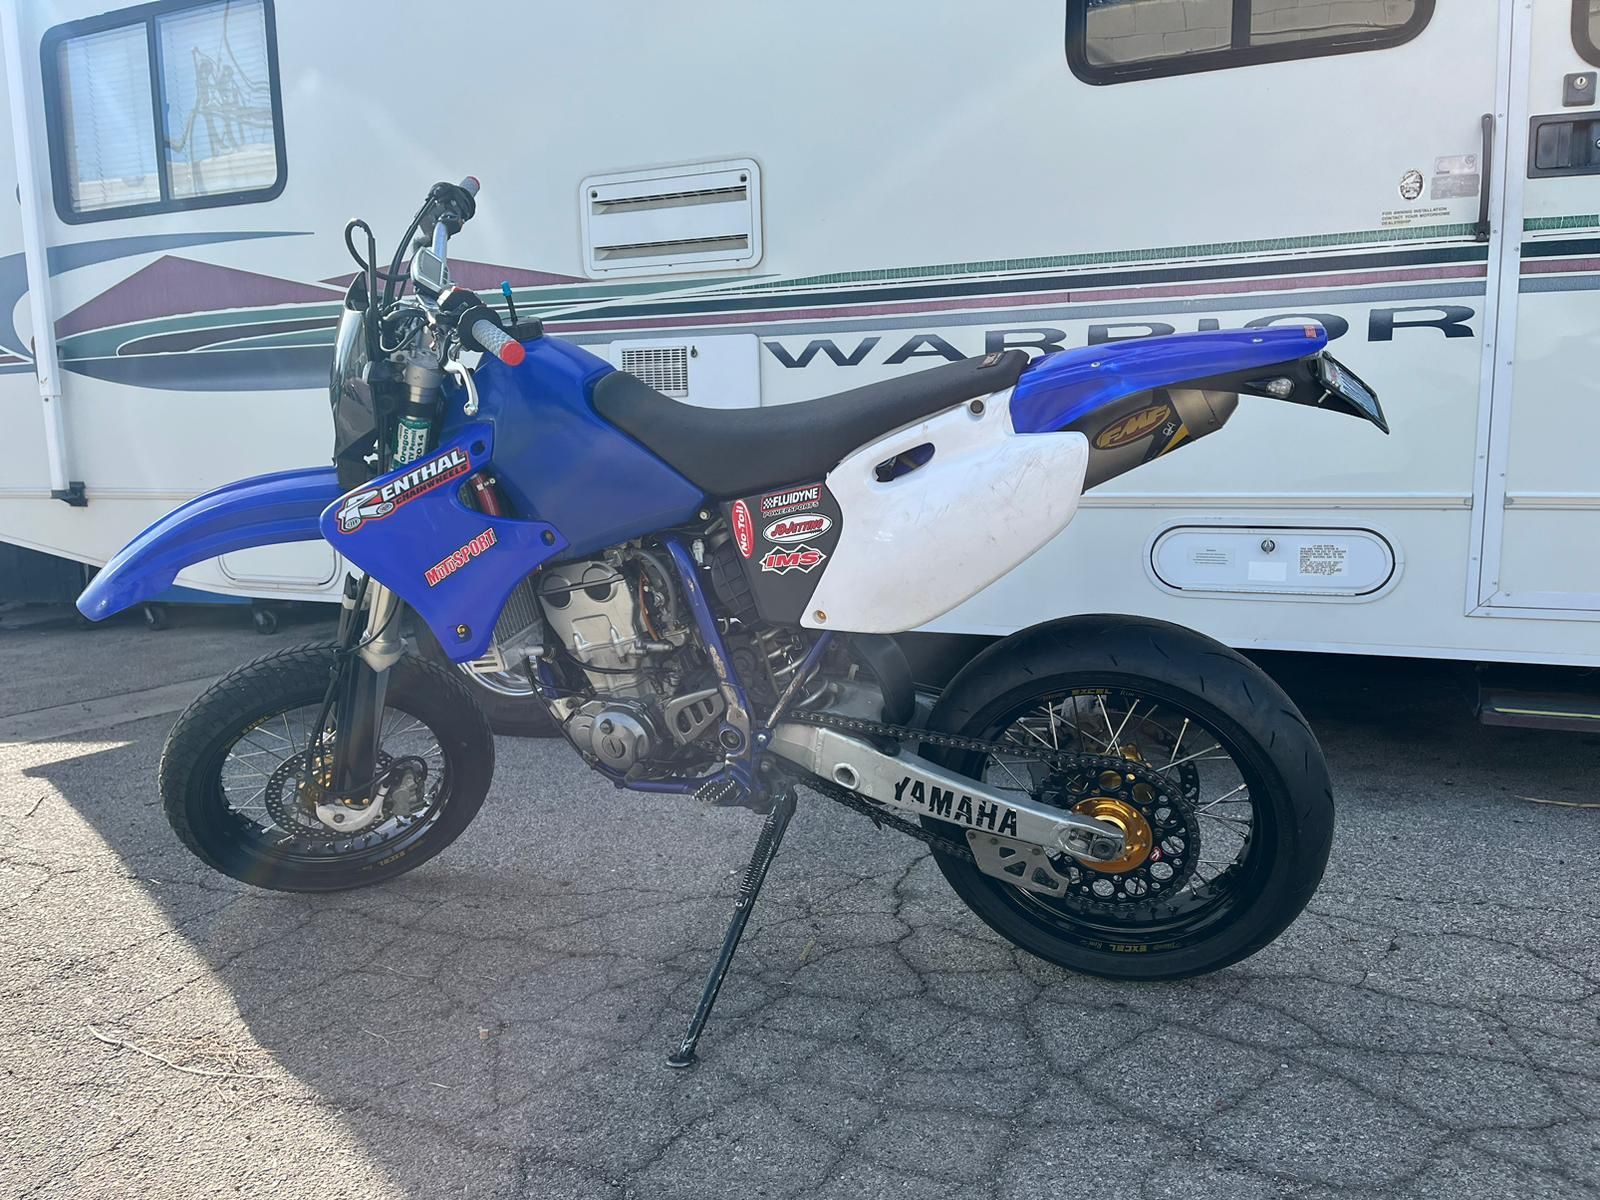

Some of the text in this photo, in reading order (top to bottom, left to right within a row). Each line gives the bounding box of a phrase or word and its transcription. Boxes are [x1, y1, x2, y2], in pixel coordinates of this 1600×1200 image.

[400, 429, 409, 462] Oregon
[1097, 404, 1170, 449] FMF
[337, 450, 467, 531] RENTHAL
[396, 464, 468, 505] CHAINWHEELS
[772, 487, 819, 508] FLUIDYNE
[766, 551, 820, 568] IMS
[894, 776, 1017, 837] YAMAHA
